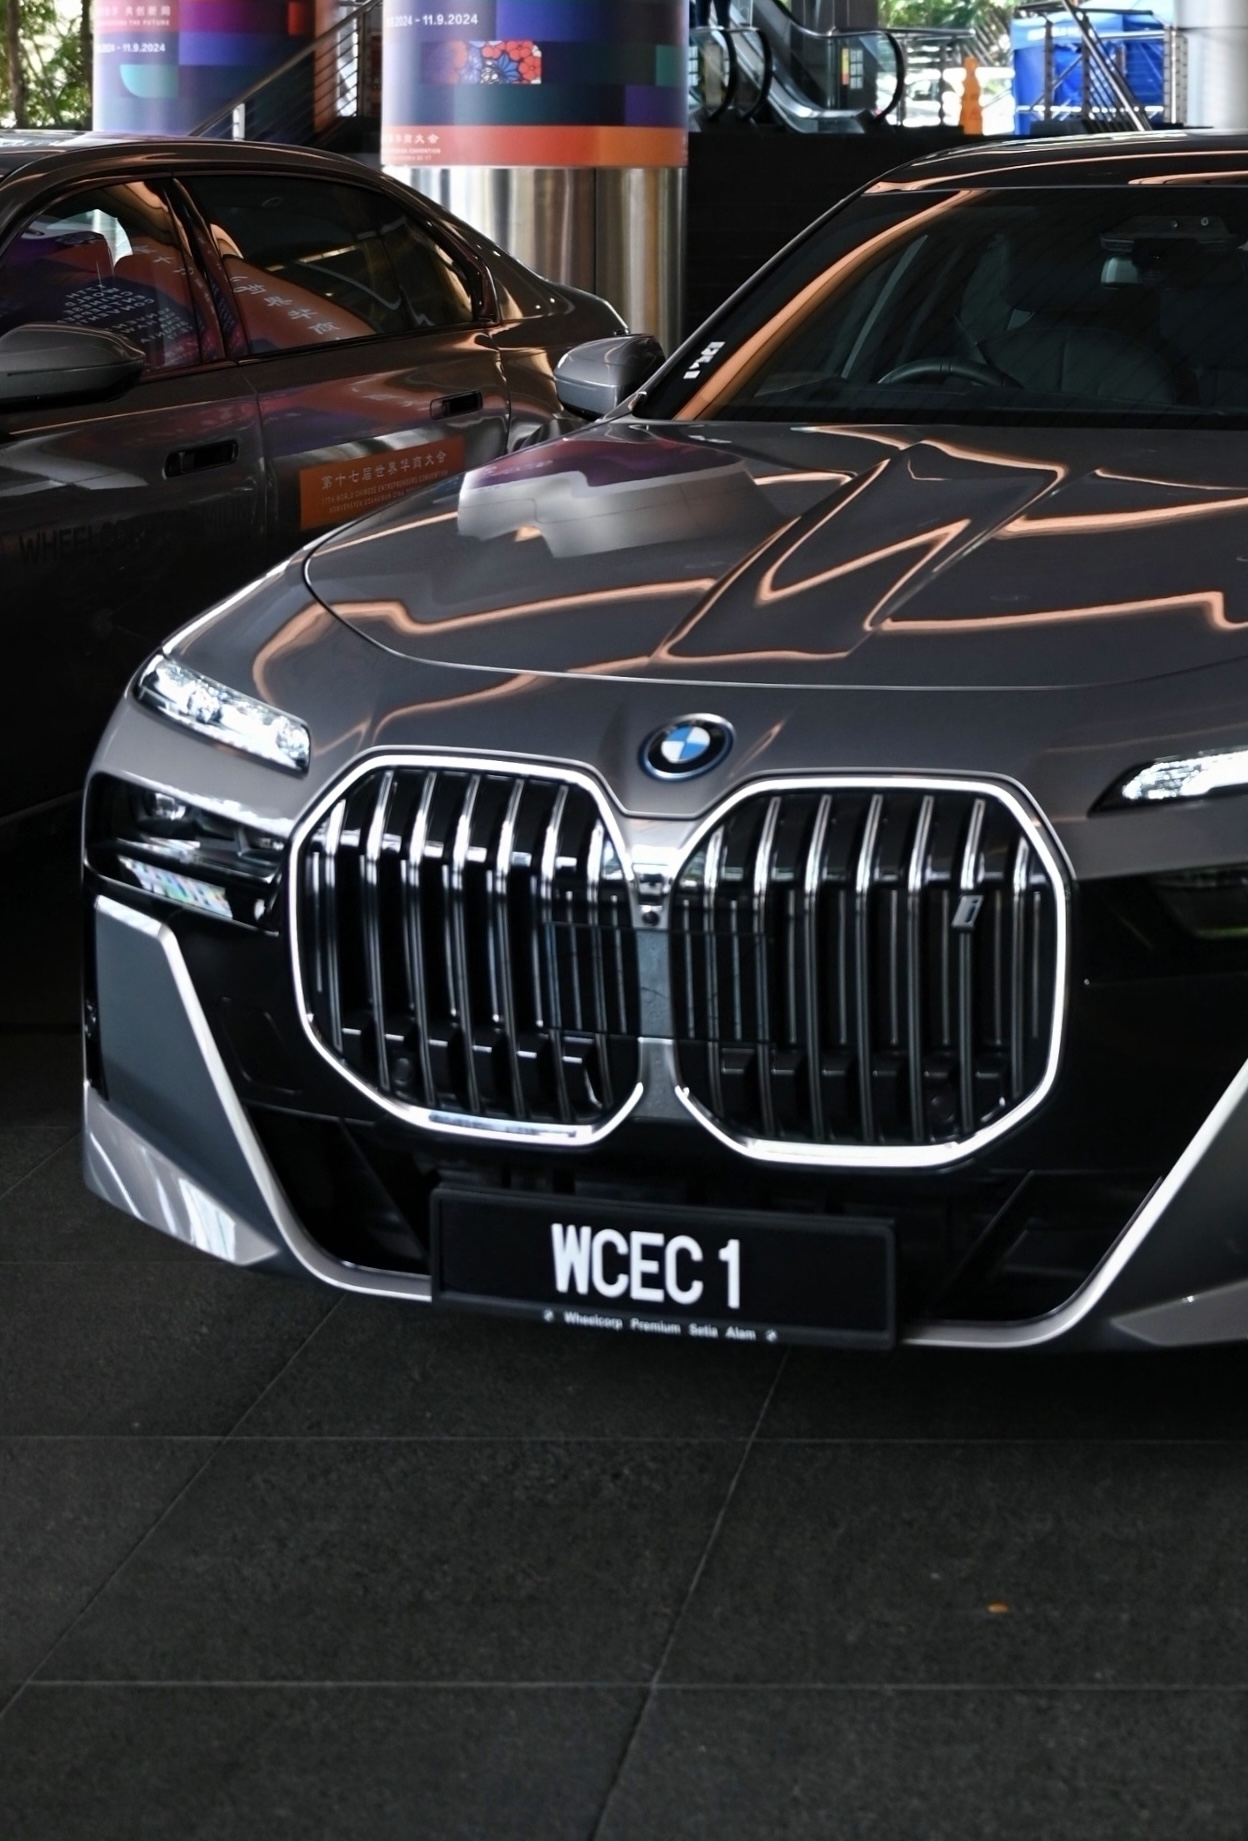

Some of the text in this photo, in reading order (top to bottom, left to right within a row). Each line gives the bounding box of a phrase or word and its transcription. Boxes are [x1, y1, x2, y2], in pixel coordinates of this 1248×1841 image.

[422, 14, 478, 26] 11.9.2024
[321, 450, 447, 490] 第十七届世界华商大会
[551, 1223, 740, 1309] WCEC 1
[563, 1311, 757, 1341] Wheelcorp Premium Setia Alam
